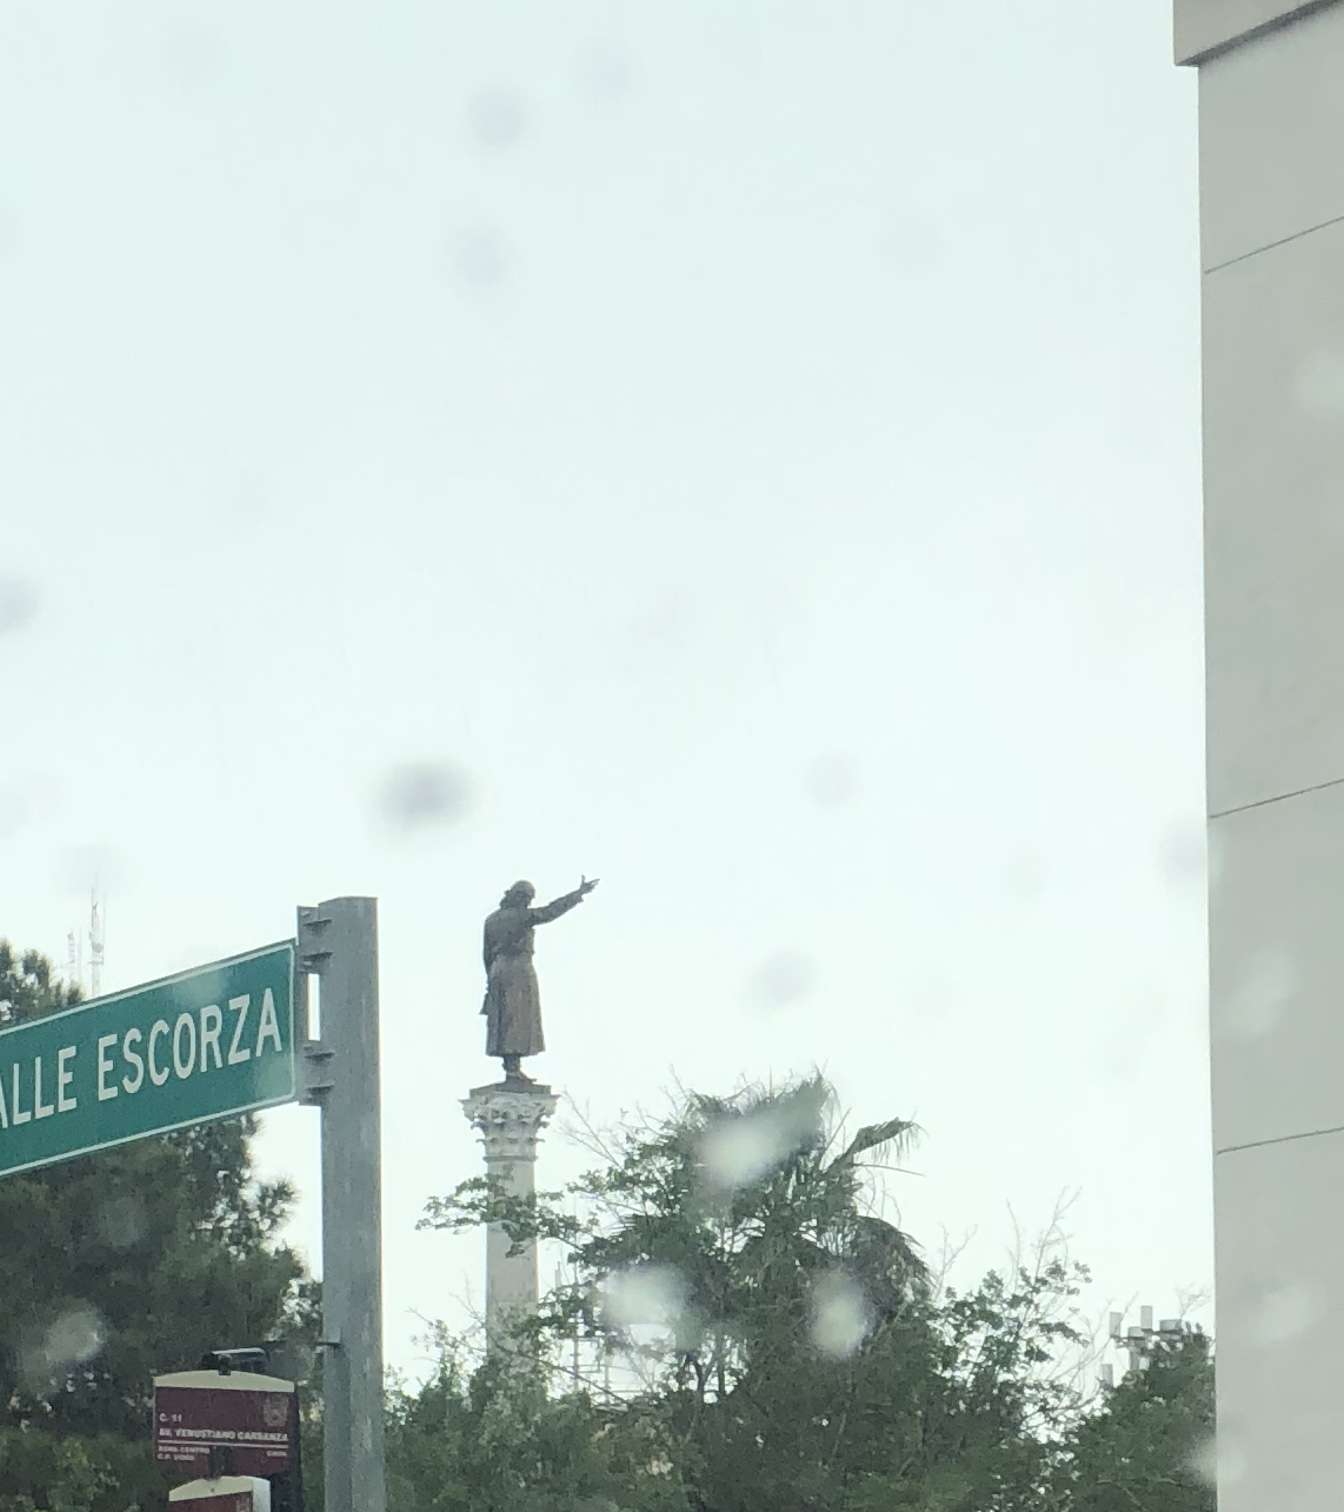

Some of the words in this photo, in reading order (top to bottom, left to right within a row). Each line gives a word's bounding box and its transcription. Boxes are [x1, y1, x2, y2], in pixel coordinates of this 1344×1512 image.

[98, 988, 283, 1101] ESCORZA
[176, 1428, 235, 1439] VENUSTIANO
[237, 1431, 288, 1441] CARRANZA
